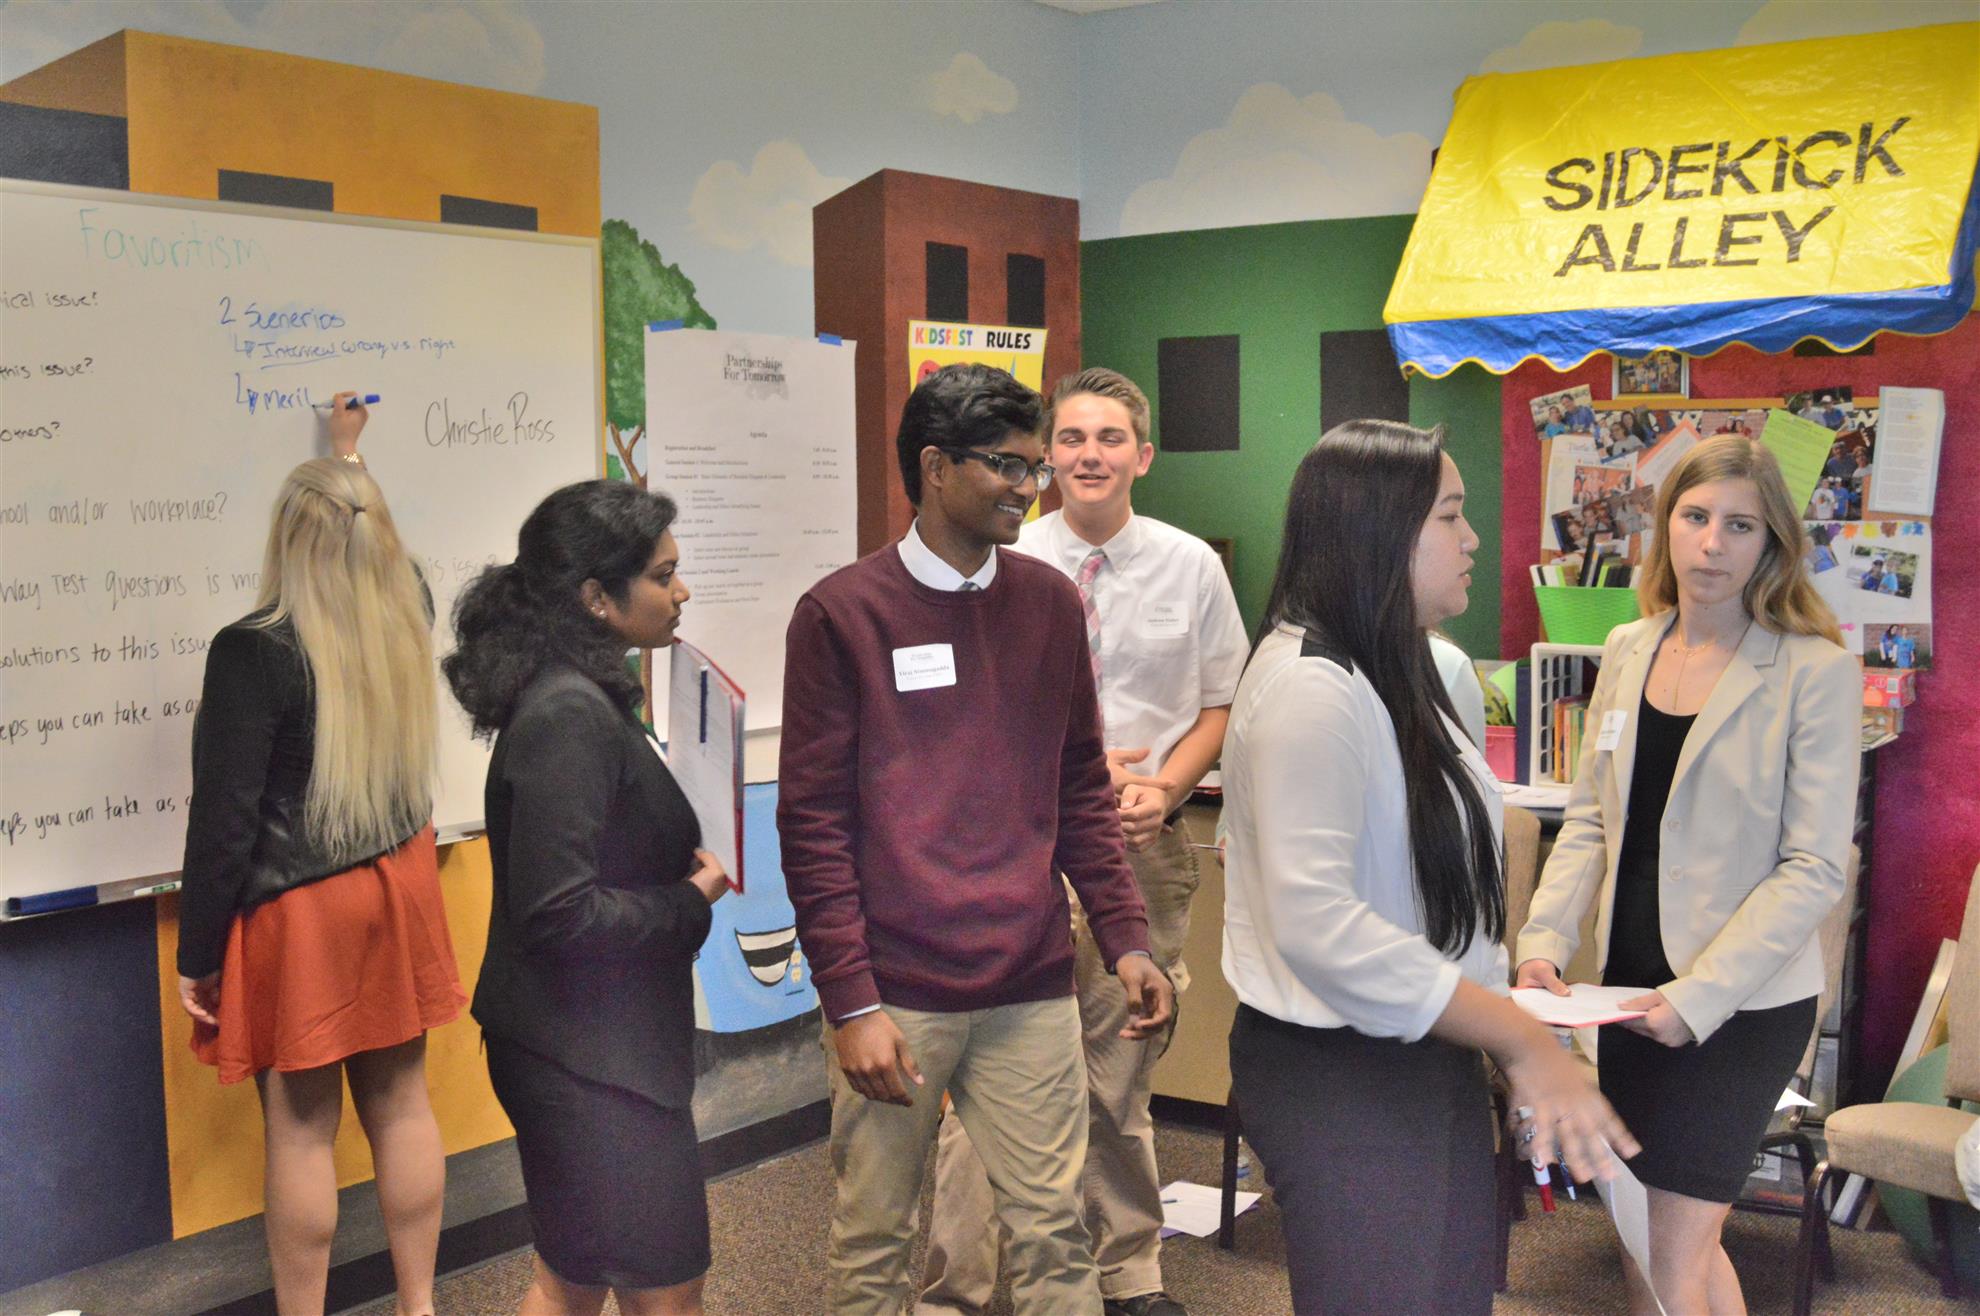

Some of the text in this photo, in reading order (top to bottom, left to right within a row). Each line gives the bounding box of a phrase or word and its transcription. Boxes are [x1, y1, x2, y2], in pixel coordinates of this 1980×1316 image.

[1541, 116, 1911, 212] SIDEKICK
[79, 208, 271, 272] Favoritism
[1553, 204, 1836, 278] ALLEY
[219, 296, 237, 325] 2
[914, 326, 1032, 350] KIDSFEST RULES
[40, 356, 94, 377] issue?
[723, 367, 740, 381] For
[726, 353, 783, 373] Partnerships
[425, 391, 556, 448] Christie Ross
[92, 642, 111, 663] to
[119, 635, 160, 662] this
[37, 714, 65, 746] you
[72, 710, 104, 729] can
[114, 700, 152, 726] take
[35, 812, 62, 840] you
[68, 806, 95, 827] can
[105, 795, 141, 821] take
[156, 797, 176, 813] as
